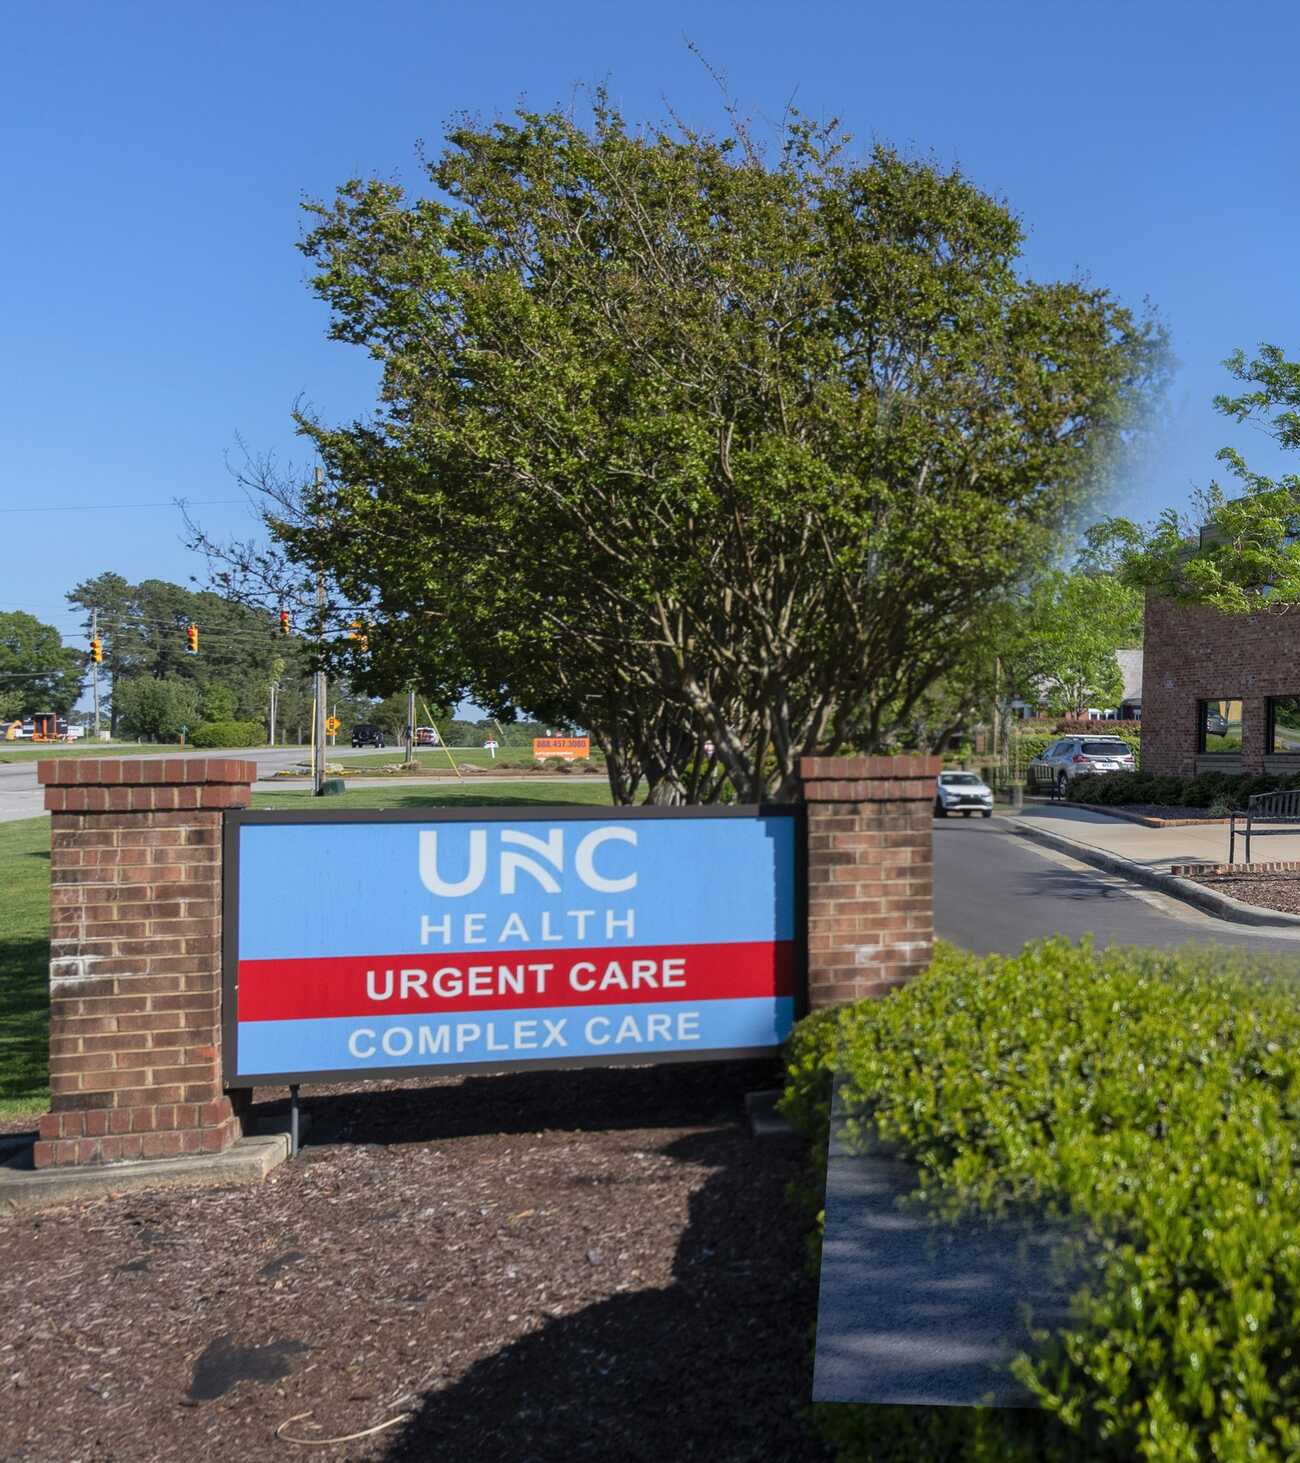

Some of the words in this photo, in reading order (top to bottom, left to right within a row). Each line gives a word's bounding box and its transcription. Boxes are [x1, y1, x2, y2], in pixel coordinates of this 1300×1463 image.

[418, 827, 638, 898] UNC
[420, 909, 636, 945] HEALTH
[366, 964, 553, 1001] URGENT
[569, 958, 687, 992] CARE
[348, 1018, 567, 1059] COMPLEX
[585, 1012, 700, 1046] CARE
